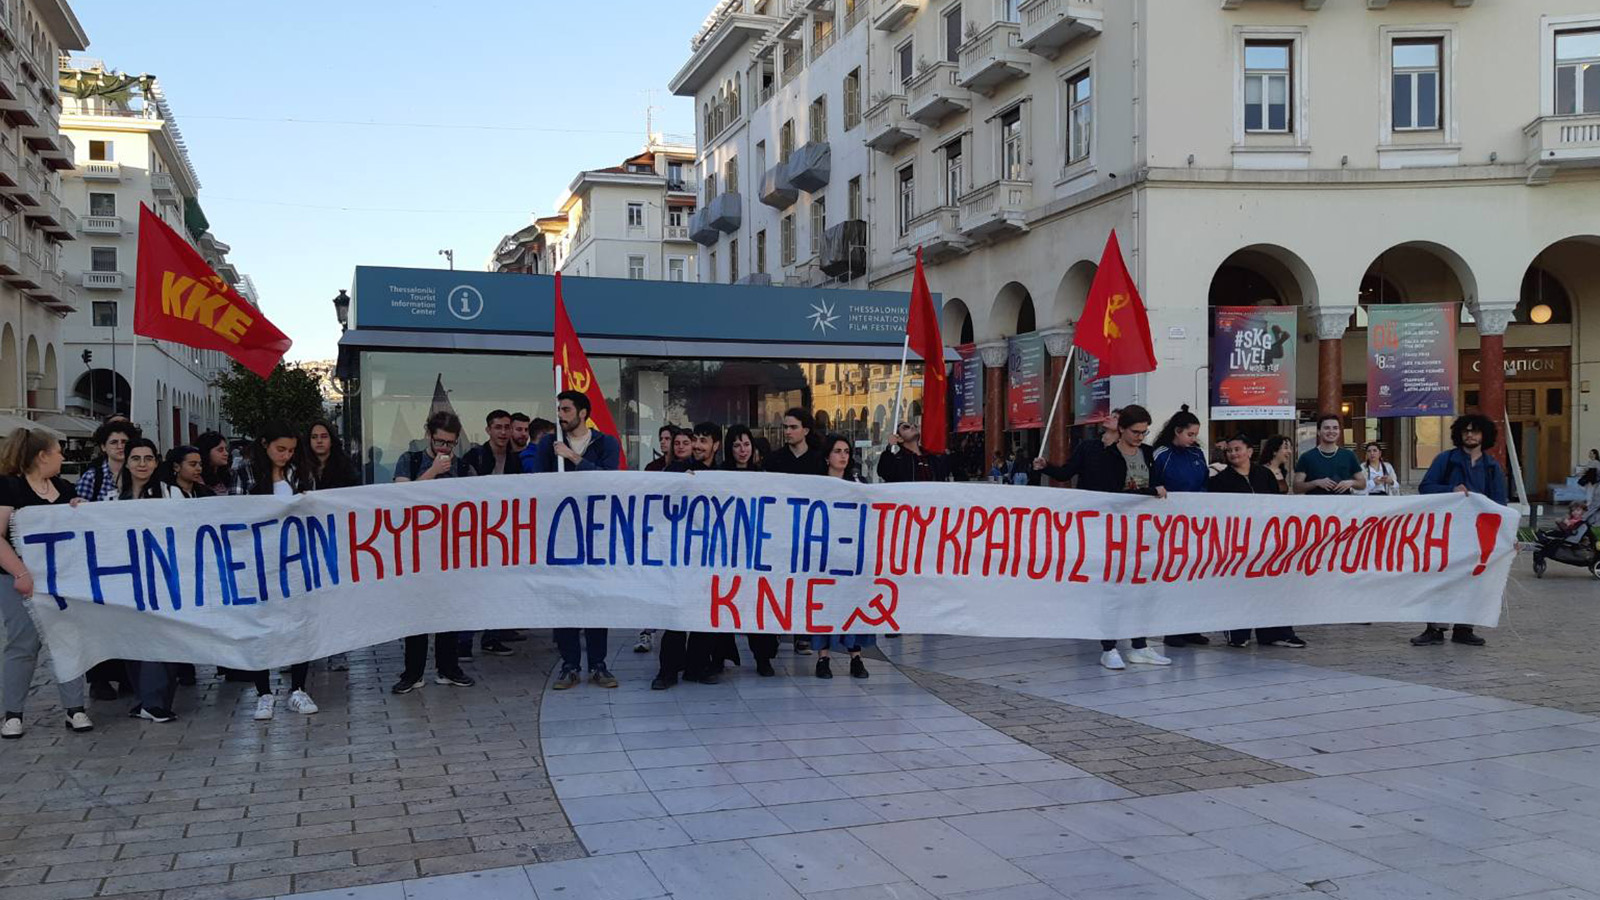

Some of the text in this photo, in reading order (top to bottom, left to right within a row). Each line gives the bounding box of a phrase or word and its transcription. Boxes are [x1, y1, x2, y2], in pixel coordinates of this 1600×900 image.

[389, 285, 436, 294] Thessaloniki
[410, 293, 436, 302] Tourist
[161, 270, 254, 344] ΚΚΕ
[391, 300, 436, 309] Information
[411, 308, 436, 316] Center
[849, 305, 909, 315] THESSALONIKI
[849, 314, 909, 323] INTERNATION
[849, 323, 868, 331] FILM
[1235, 328, 1272, 350] #SKG
[1230, 347, 1266, 371] LIVE!
[1374, 353, 1386, 369] 18
[24, 526, 182, 611] ΤΗΝ
[194, 513, 340, 607] ΛΕΓΑΝ
[347, 497, 538, 583] ΚΥΡΙΑΚΗ
[546, 494, 636, 566] ΔΕΝ
[641, 494, 778, 572] ΕΨΑΧΝΕ
[786, 496, 867, 577] ΤΑΞΙ
[872, 502, 936, 577] ΤΟΥ
[1103, 513, 1128, 584] Η
[1131, 512, 1251, 584] ΕΥΘΥΝΗ
[710, 574, 837, 633] ΚΝΕ
